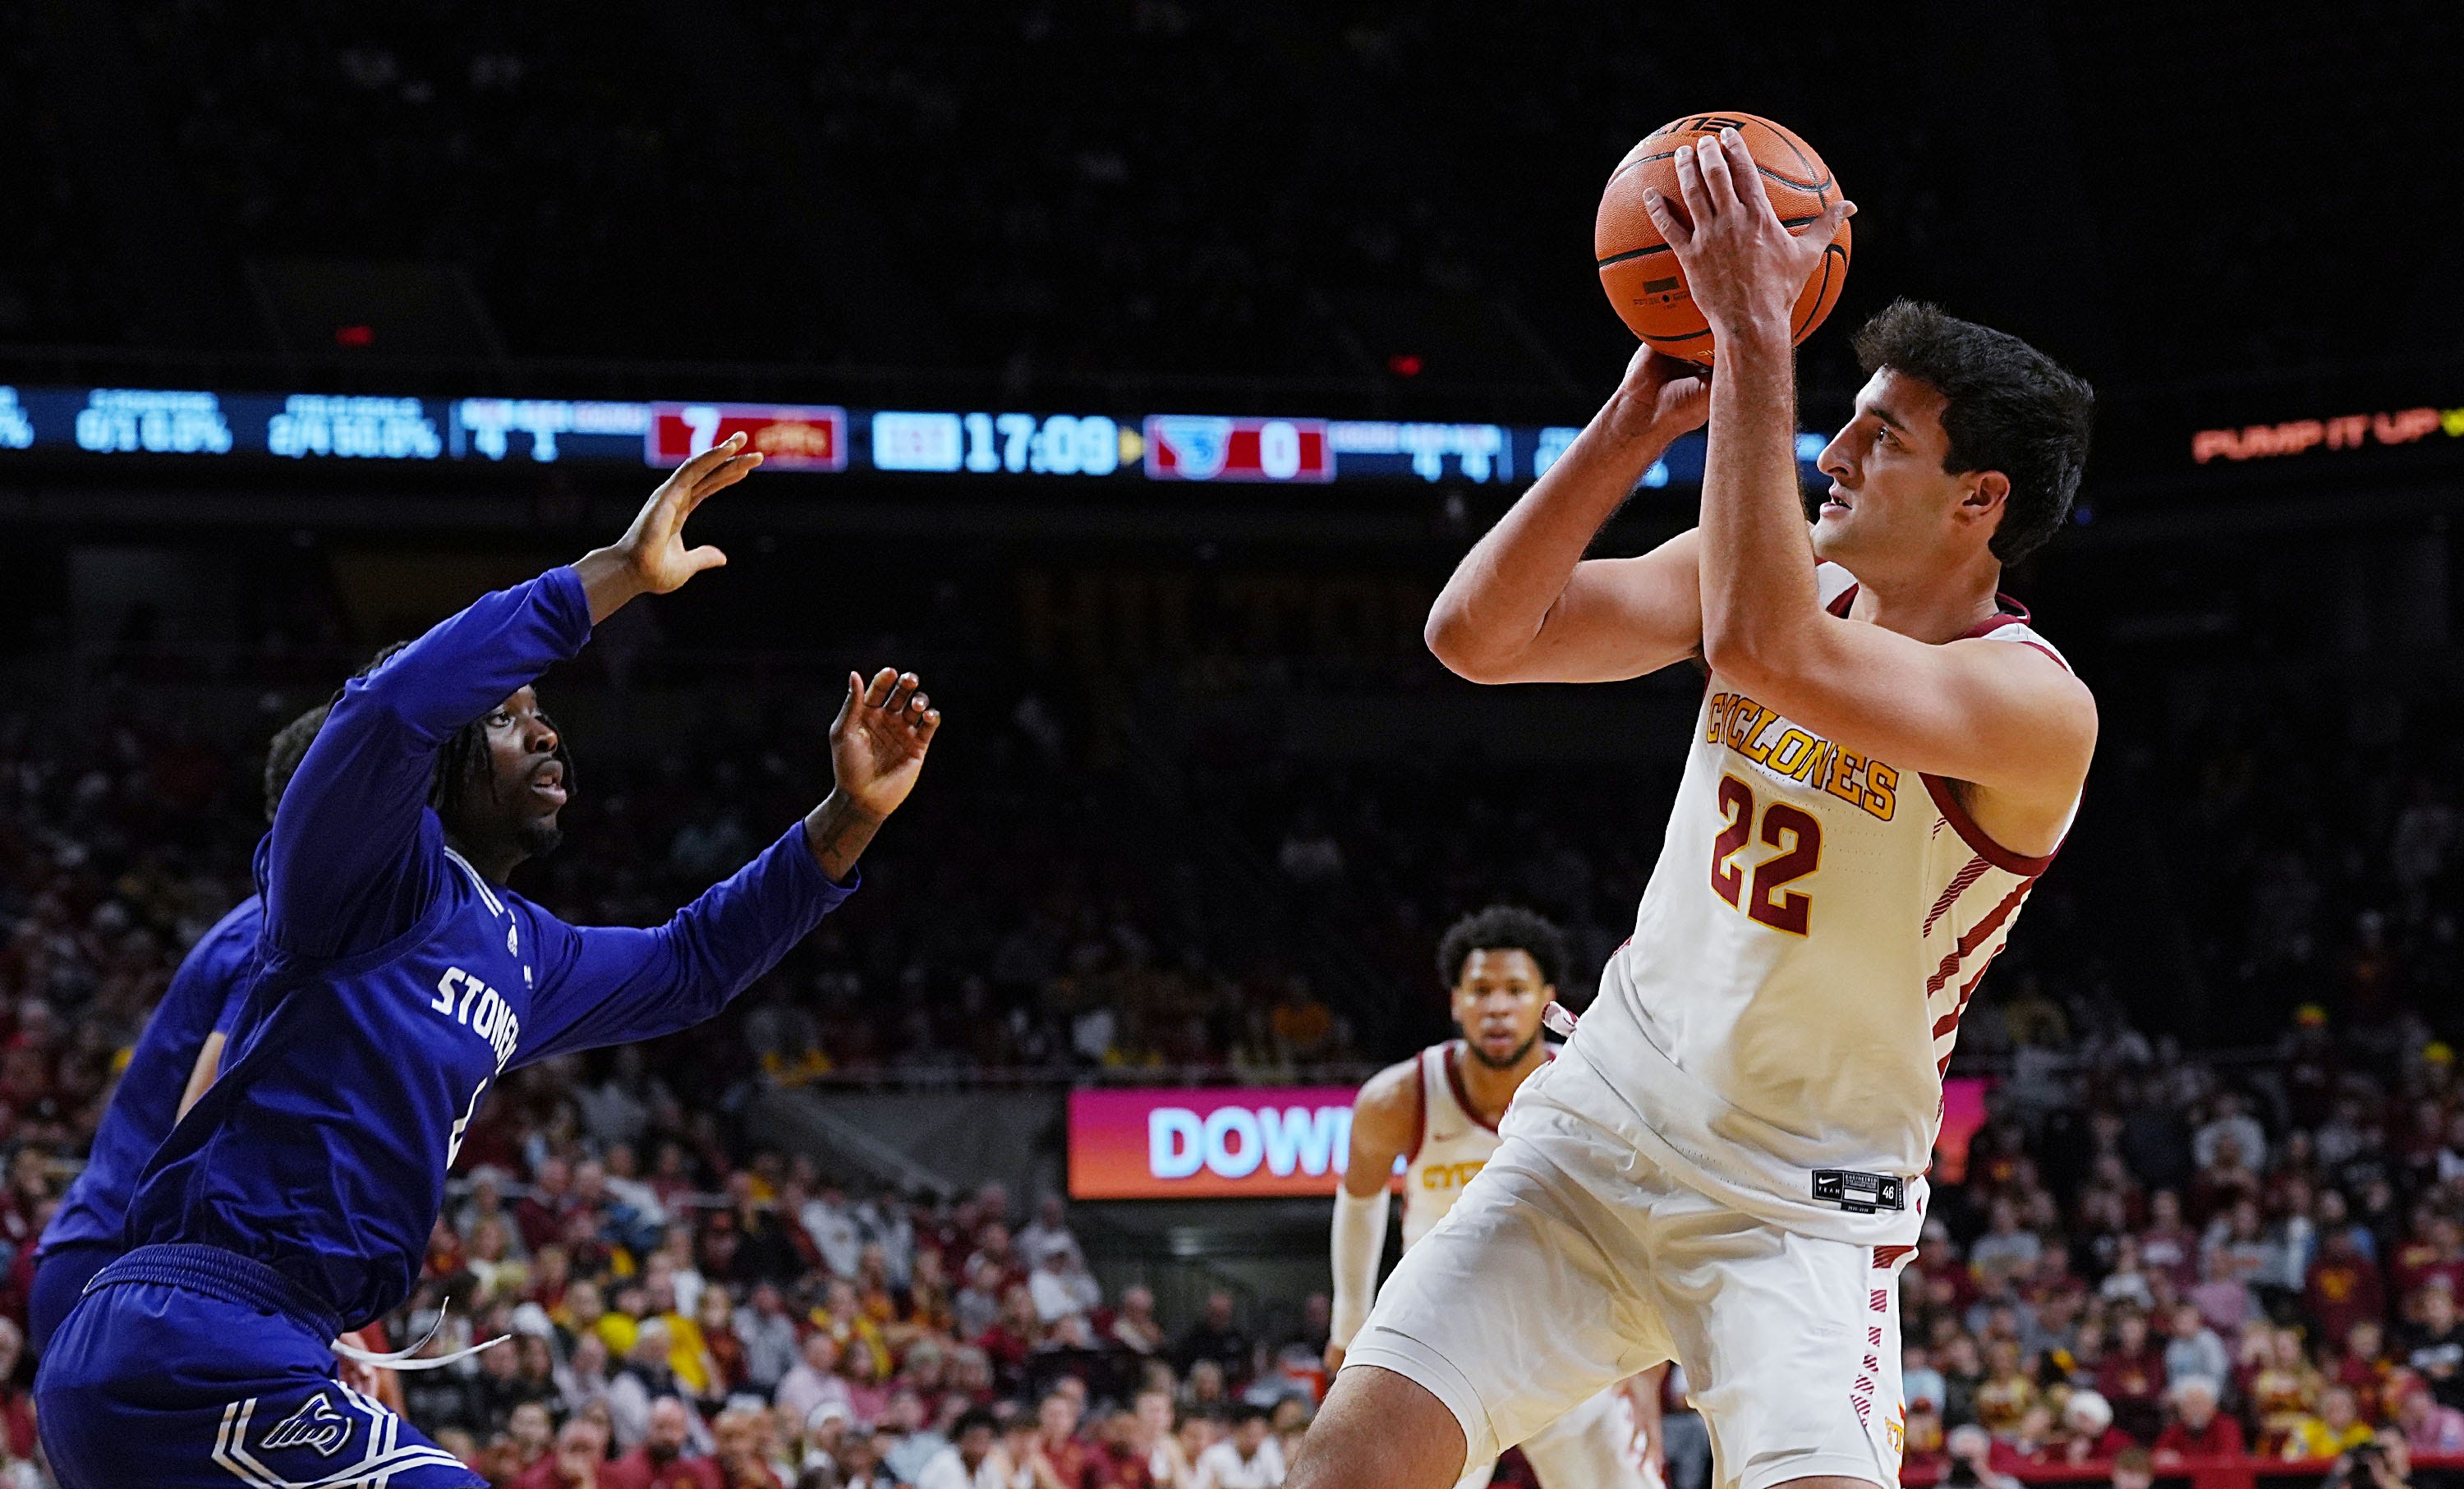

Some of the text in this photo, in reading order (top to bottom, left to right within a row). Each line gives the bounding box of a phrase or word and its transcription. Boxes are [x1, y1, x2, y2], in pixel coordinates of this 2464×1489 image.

[963, 411, 1119, 476] 17:09
[1258, 421, 1302, 479] 0
[2191, 419, 2324, 465] PUMP
[2373, 407, 2440, 444] UP
[1706, 692, 1901, 822] CYCLONES
[1710, 772, 1824, 939] 22
[1818, 1185, 1841, 1195] TEAM
